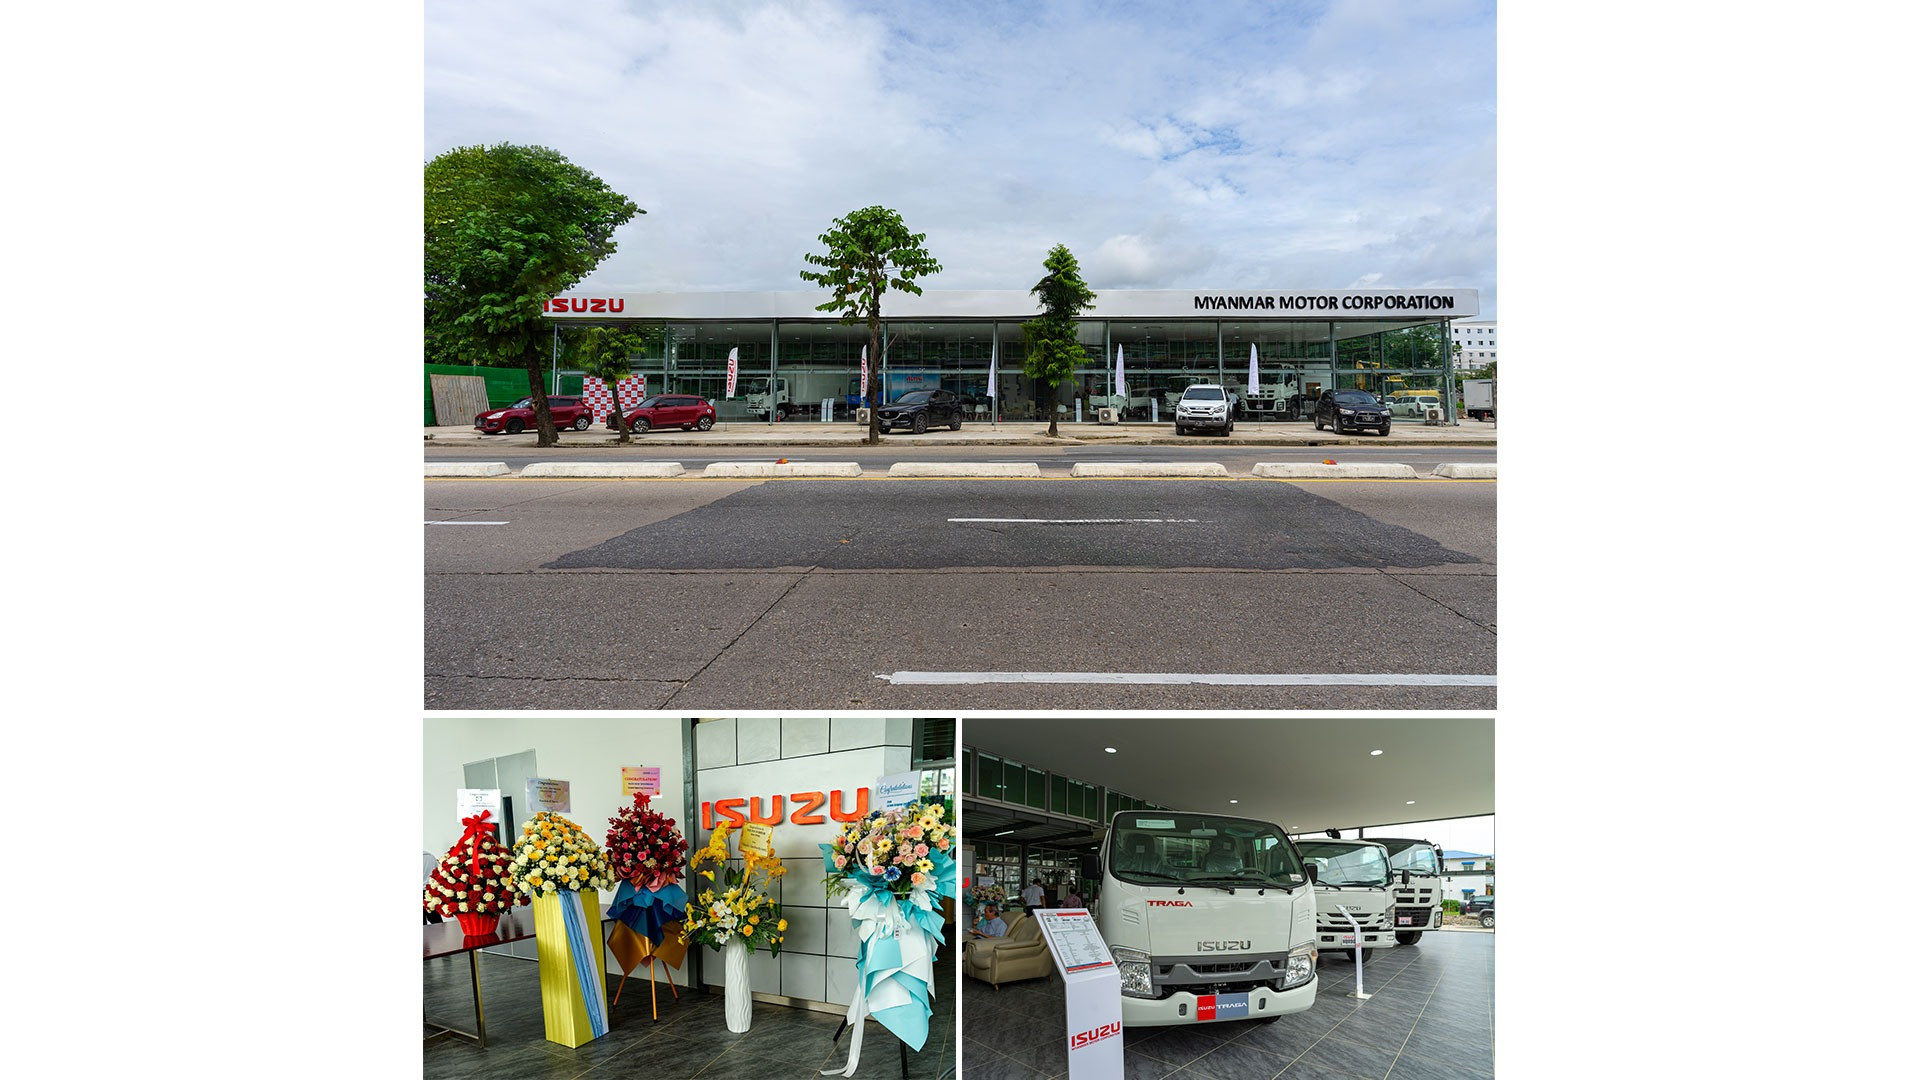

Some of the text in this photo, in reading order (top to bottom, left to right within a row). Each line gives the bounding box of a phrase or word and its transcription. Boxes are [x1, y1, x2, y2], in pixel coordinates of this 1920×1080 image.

[544, 298, 625, 313] ISUZU
[1194, 295, 1455, 310] MYANMAR MOTOR CORPORATION
[701, 787, 869, 830] ISUZU
[1146, 900, 1193, 908] TRAGA
[1197, 940, 1252, 952] ISUZU
[1071, 1021, 1121, 1048] ISUZU
